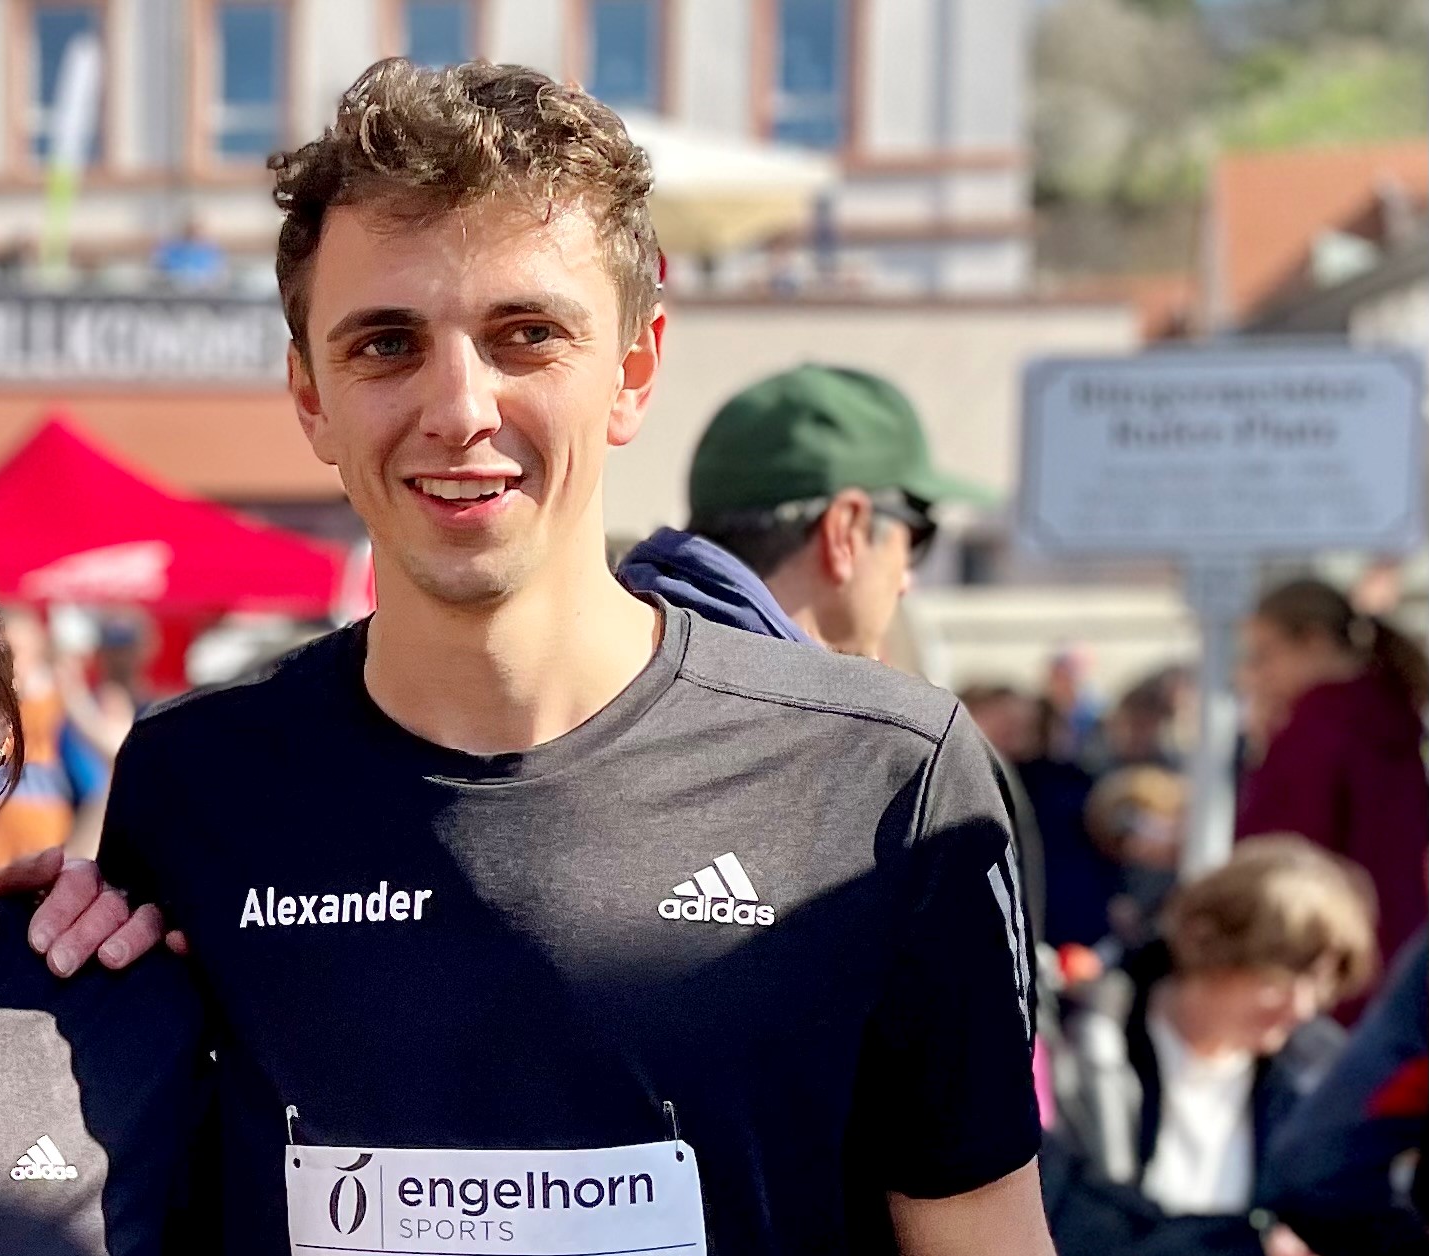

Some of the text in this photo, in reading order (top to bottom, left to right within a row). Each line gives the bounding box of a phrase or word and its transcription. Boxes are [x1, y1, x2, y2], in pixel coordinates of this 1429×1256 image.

[238, 880, 432, 928] Alexander
[657, 896, 775, 926] adidas
[10, 1163, 78, 1181] adidas
[398, 1171, 654, 1216] engelhorn
[399, 1218, 515, 1242] SPORTS
